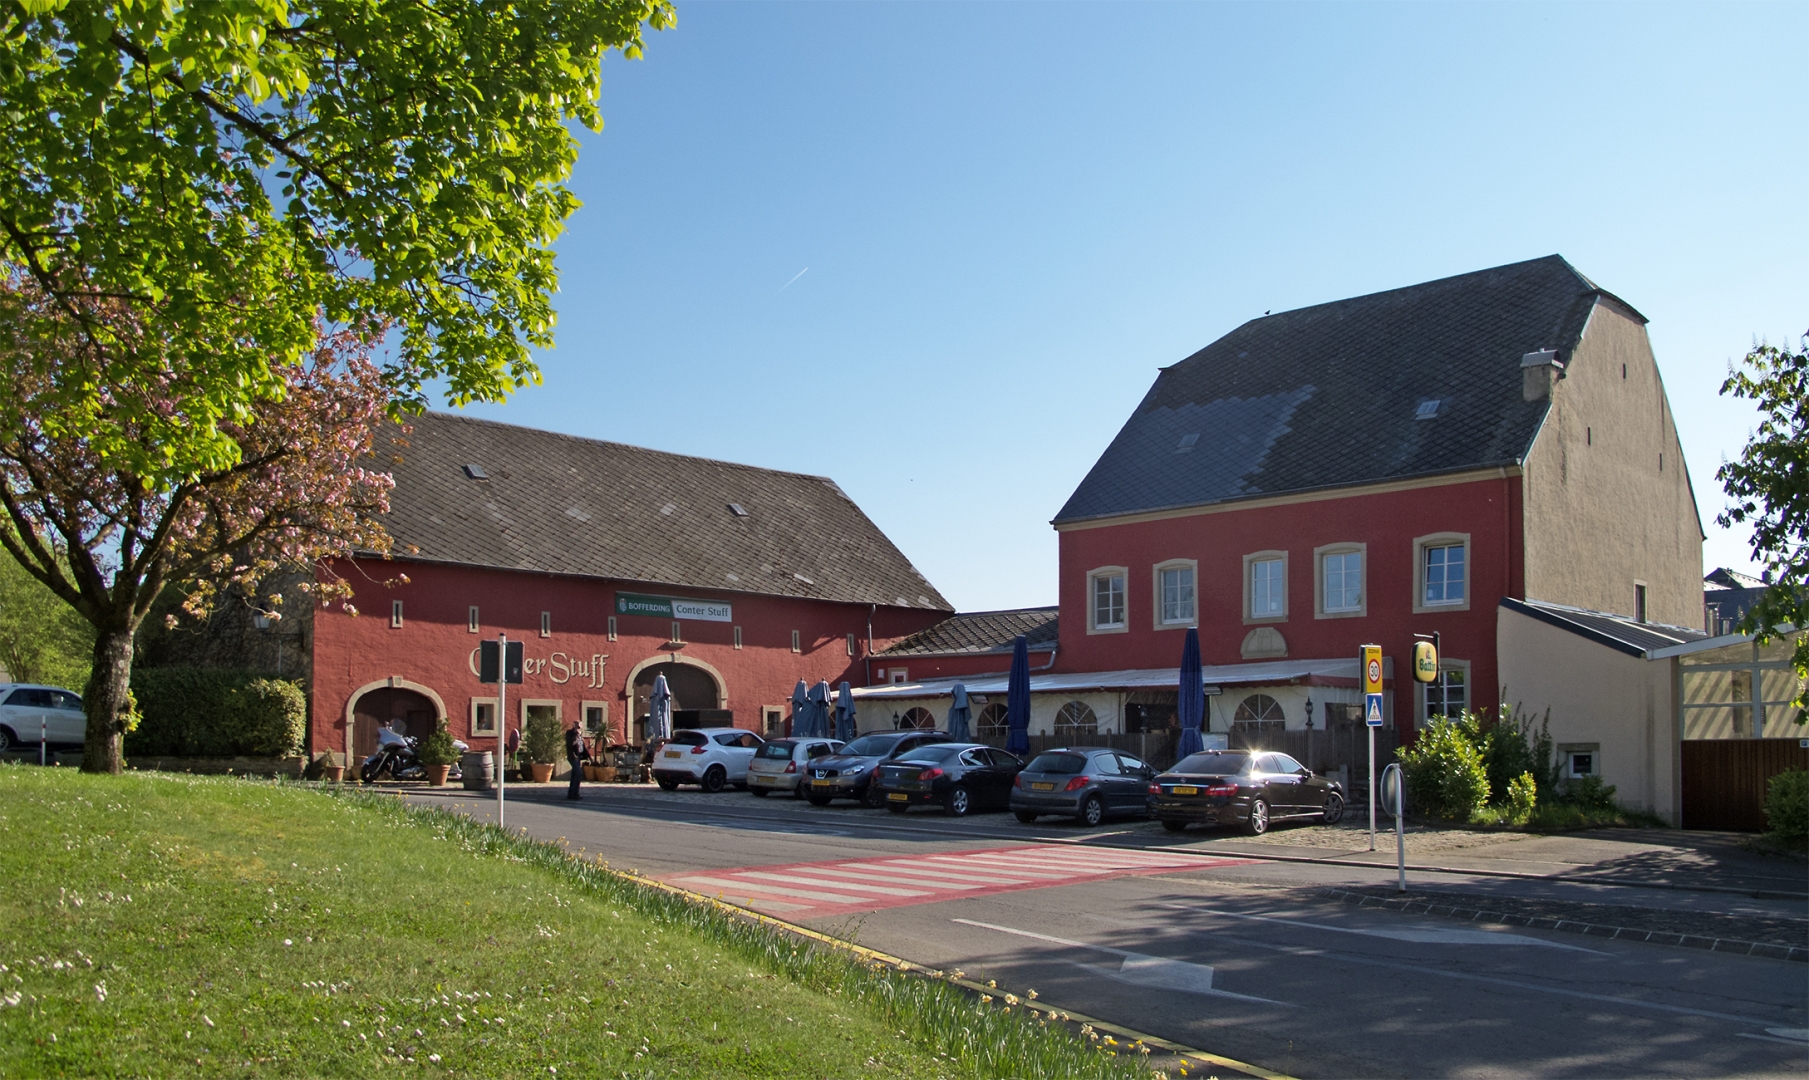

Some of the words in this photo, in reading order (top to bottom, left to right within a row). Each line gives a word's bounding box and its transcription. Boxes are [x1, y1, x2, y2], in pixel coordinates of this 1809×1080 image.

[628, 602, 671, 613] BOFFERDING
[676, 604, 705, 616] Conter
[707, 606, 729, 617] Stuff
[549, 652, 609, 689] Stuff
[1370, 665, 1378, 677] 30
